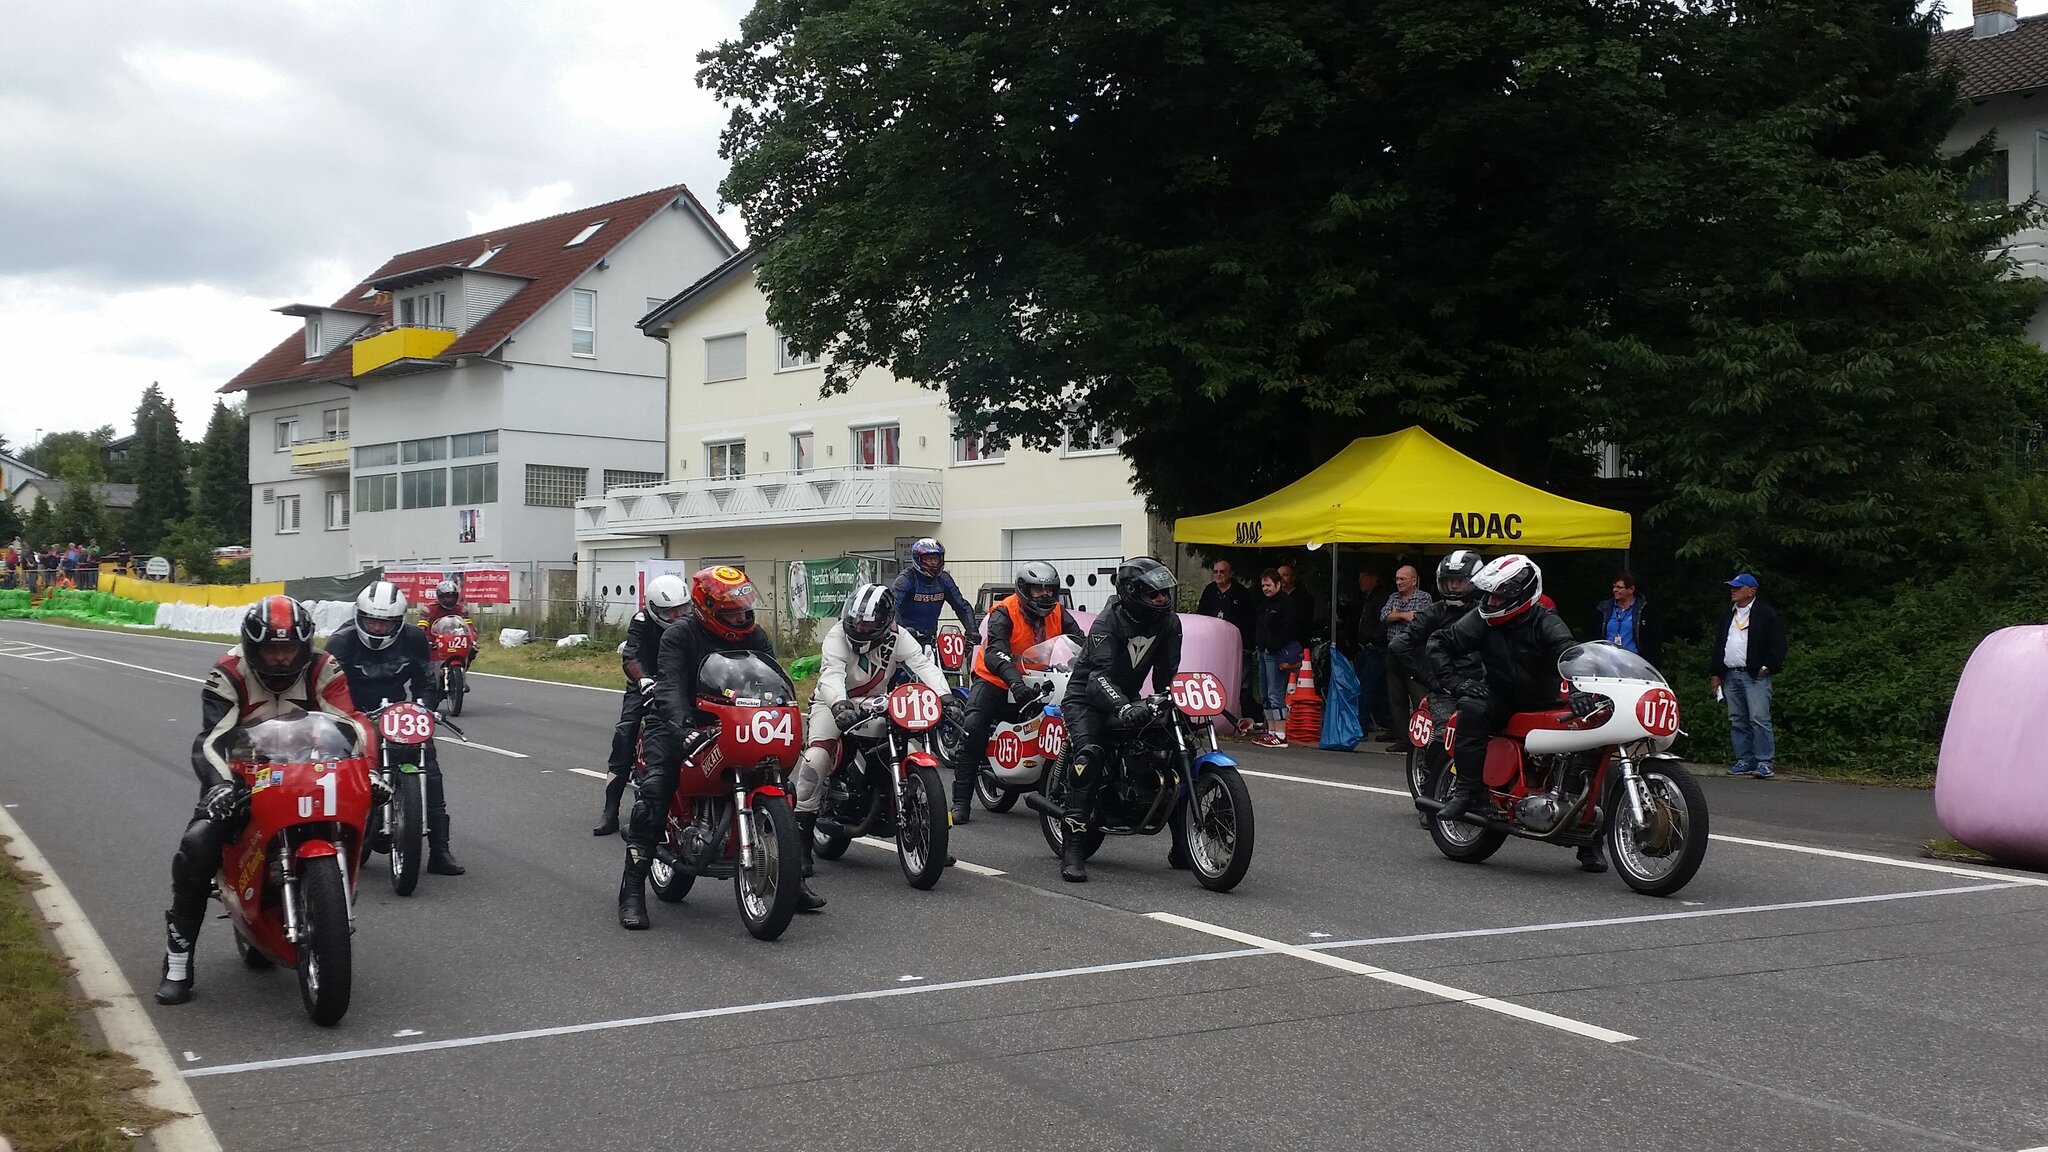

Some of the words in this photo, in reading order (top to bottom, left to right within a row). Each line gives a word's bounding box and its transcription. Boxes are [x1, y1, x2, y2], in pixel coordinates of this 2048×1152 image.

[1232, 520, 1262, 544] ADAC
[1450, 512, 1522, 540] ADAC
[943, 635, 964, 656] 30
[892, 689, 939, 721] U18
[1173, 679, 1222, 710] U66
[383, 713, 430, 737] U38
[735, 710, 794, 747] U64
[1409, 714, 1433, 745] U55
[1643, 698, 1678, 731] U73
[998, 737, 1018, 763] U51
[1039, 723, 1063, 756] U66
[702, 747, 723, 776] DUCATI
